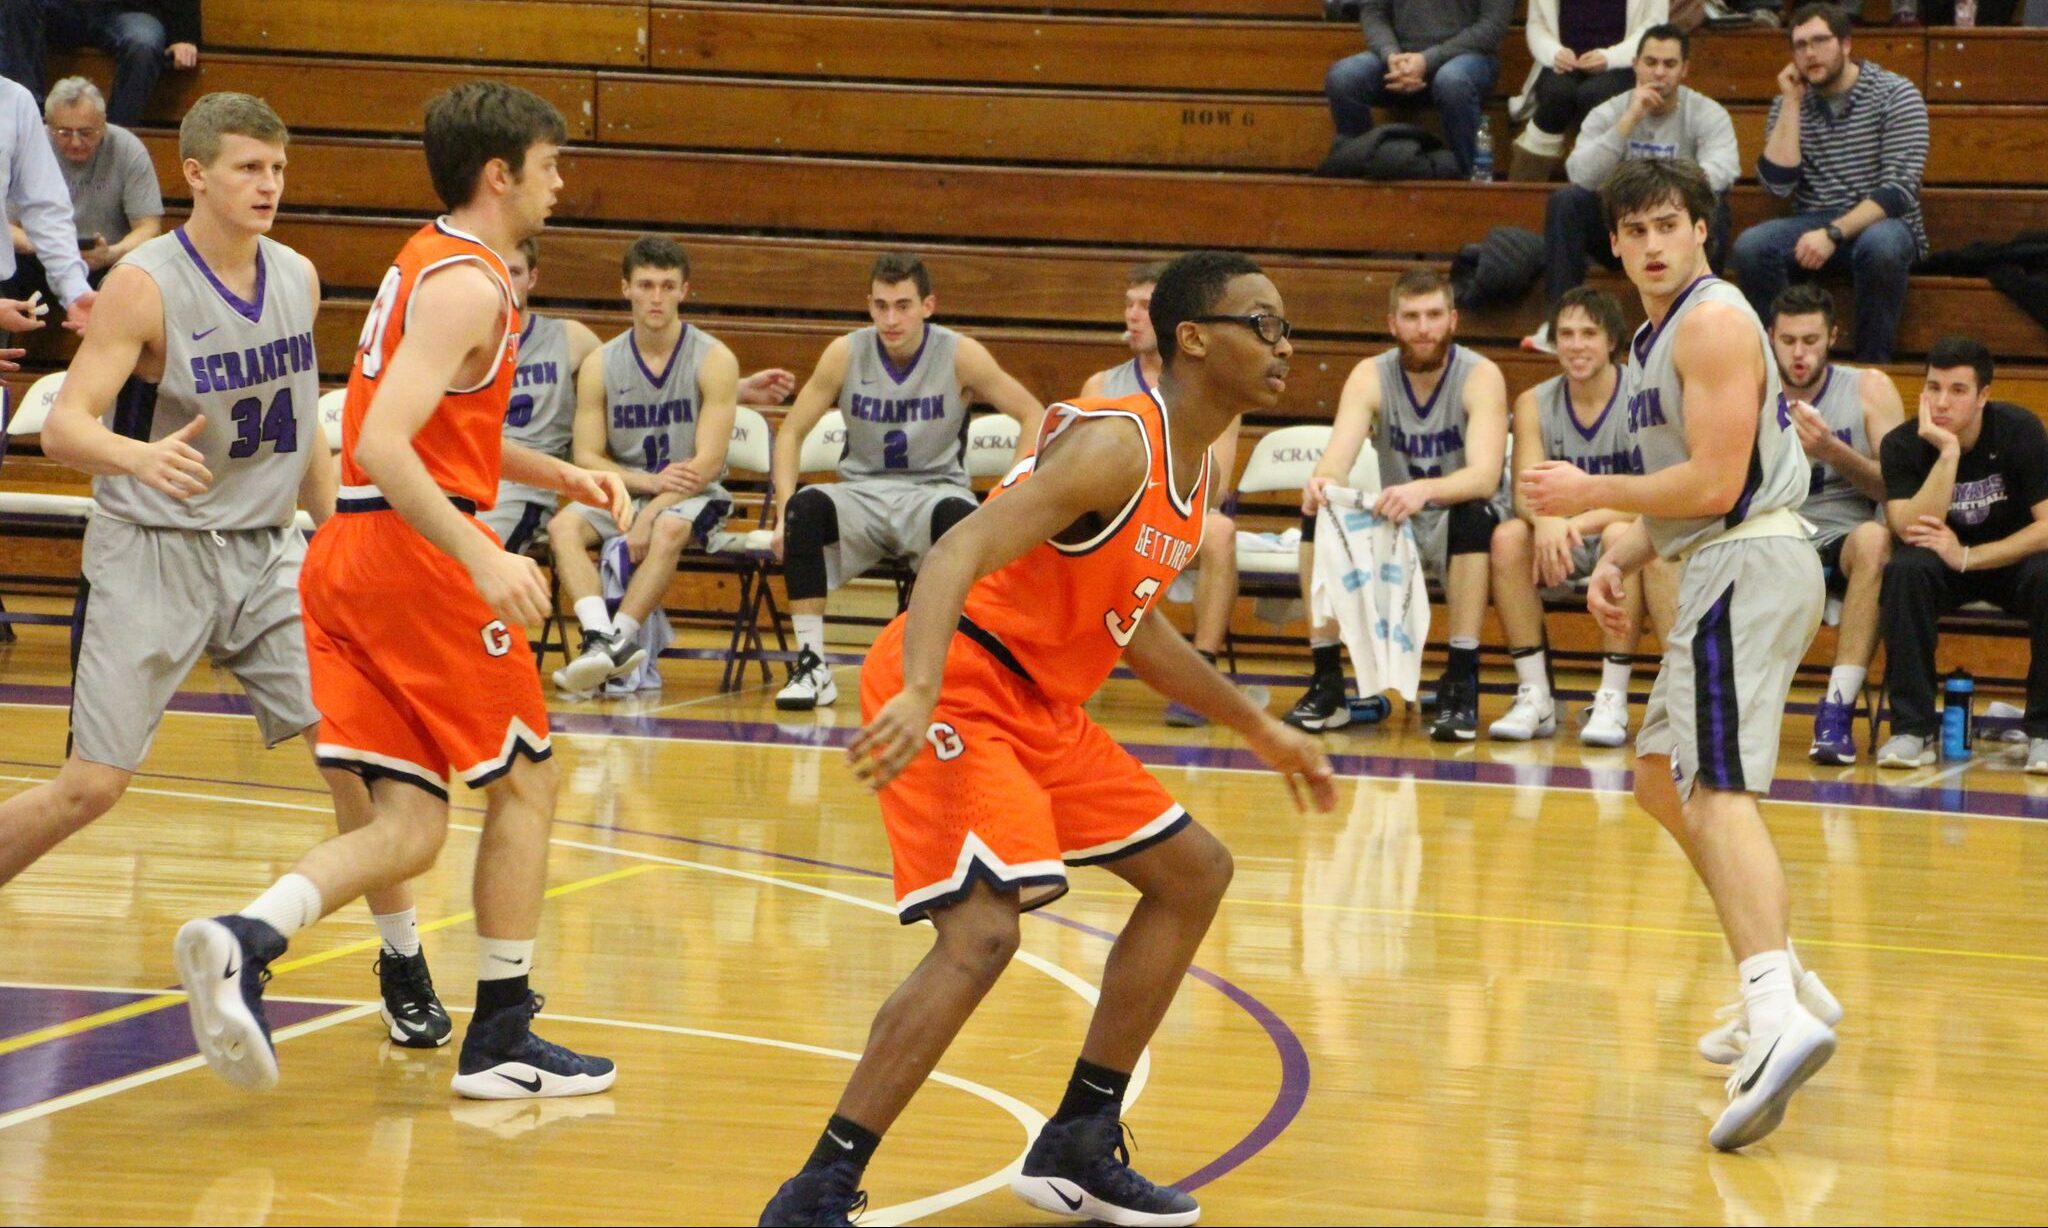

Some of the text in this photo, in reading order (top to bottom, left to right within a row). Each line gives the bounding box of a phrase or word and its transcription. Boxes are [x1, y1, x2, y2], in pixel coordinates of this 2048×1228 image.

[1182, 109, 1231, 126] ROW
[190, 331, 313, 394] SCRANTON
[228, 387, 297, 459] 34
[504, 393, 534, 429] 0
[613, 398, 693, 429] SCRANTON
[852, 392, 945, 424] SCRANTON
[642, 432, 671, 474] 12
[883, 429, 909, 469] 2
[972, 435, 1017, 450] SCRA
[480, 619, 512, 657] G
[926, 722, 966, 762] G
